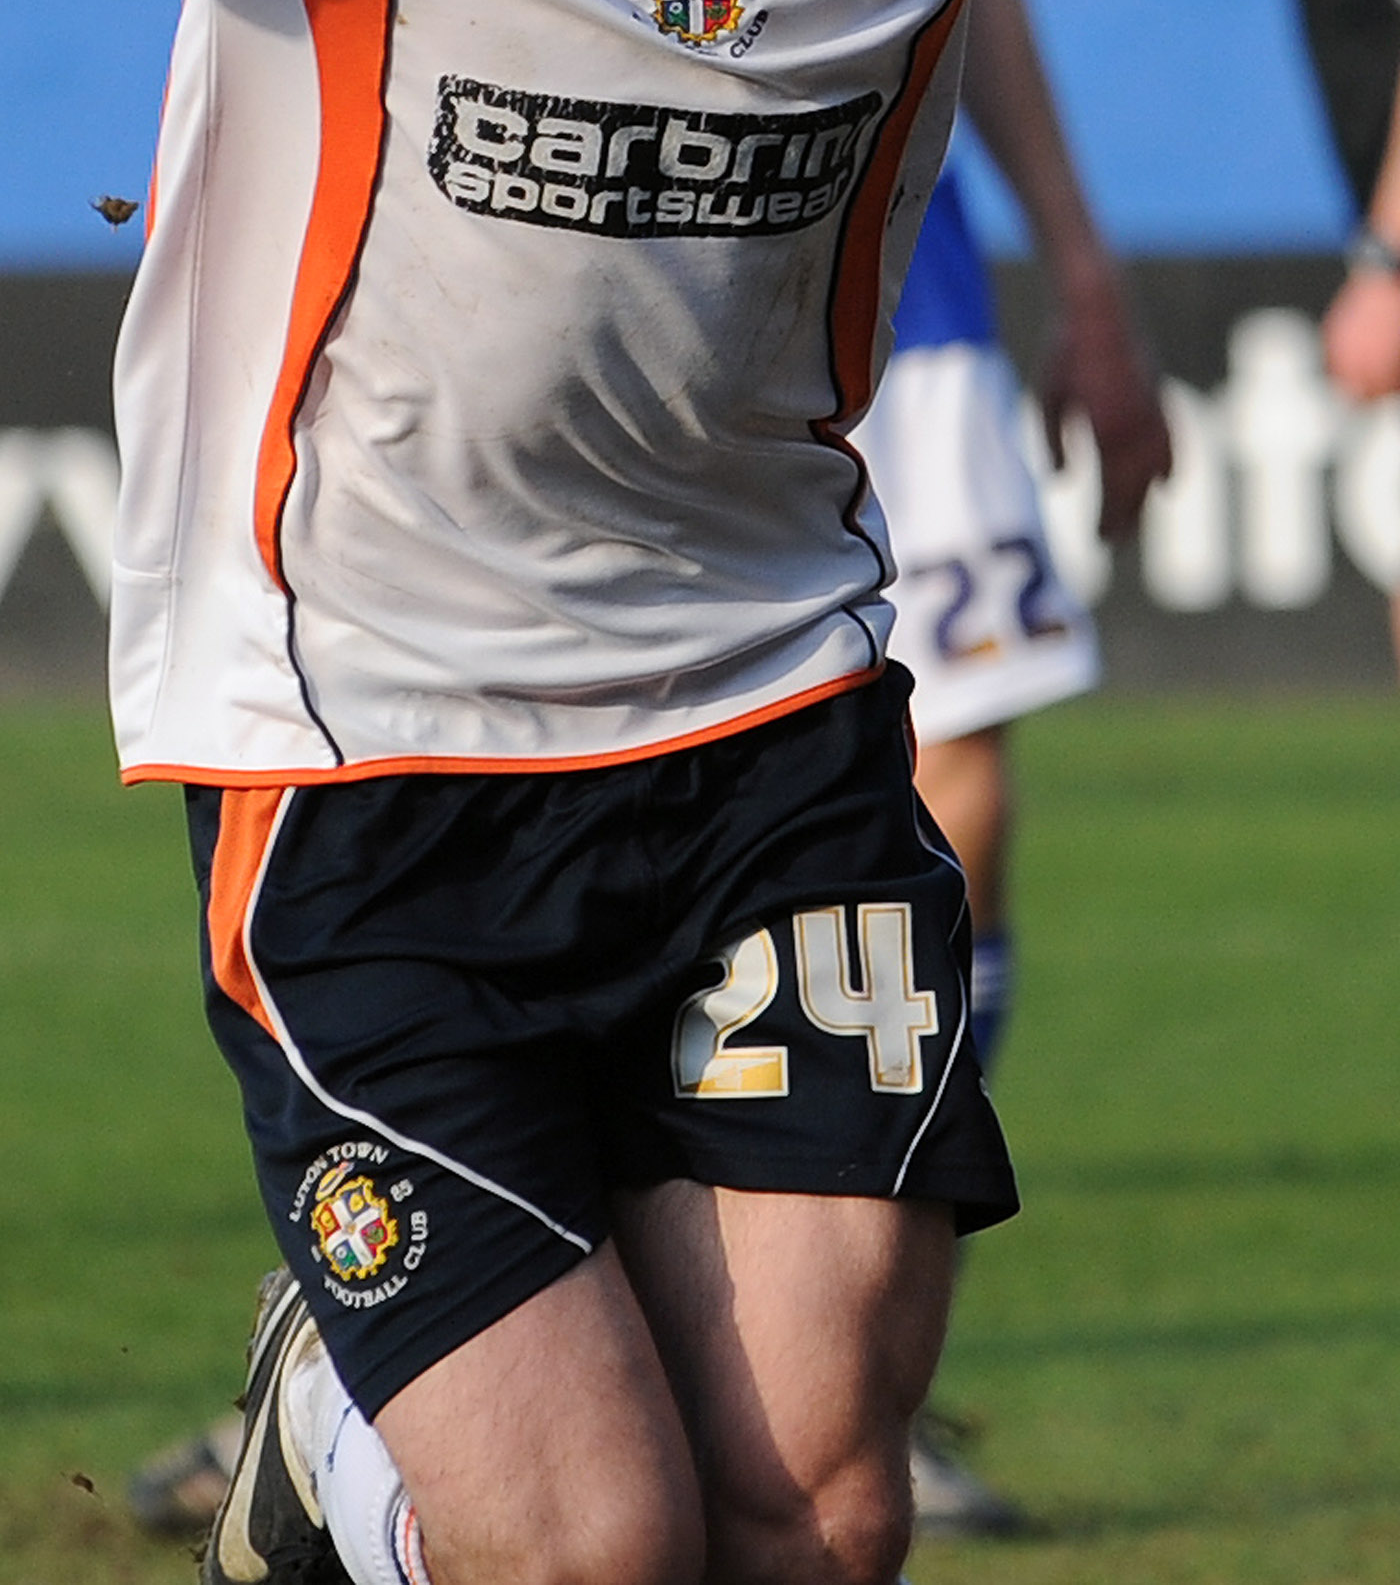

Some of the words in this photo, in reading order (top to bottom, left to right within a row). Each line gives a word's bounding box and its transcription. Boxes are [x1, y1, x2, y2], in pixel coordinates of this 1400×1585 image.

[730, 9, 769, 59] CLUB
[443, 160, 849, 226] sportswear
[906, 536, 1069, 661] 22
[670, 902, 939, 1099] 24
[288, 1154, 328, 1223] LUTON
[326, 1141, 389, 1165] TOWN
[323, 1274, 409, 1310] FOOTBALL
[403, 1210, 429, 1271] CLUB
